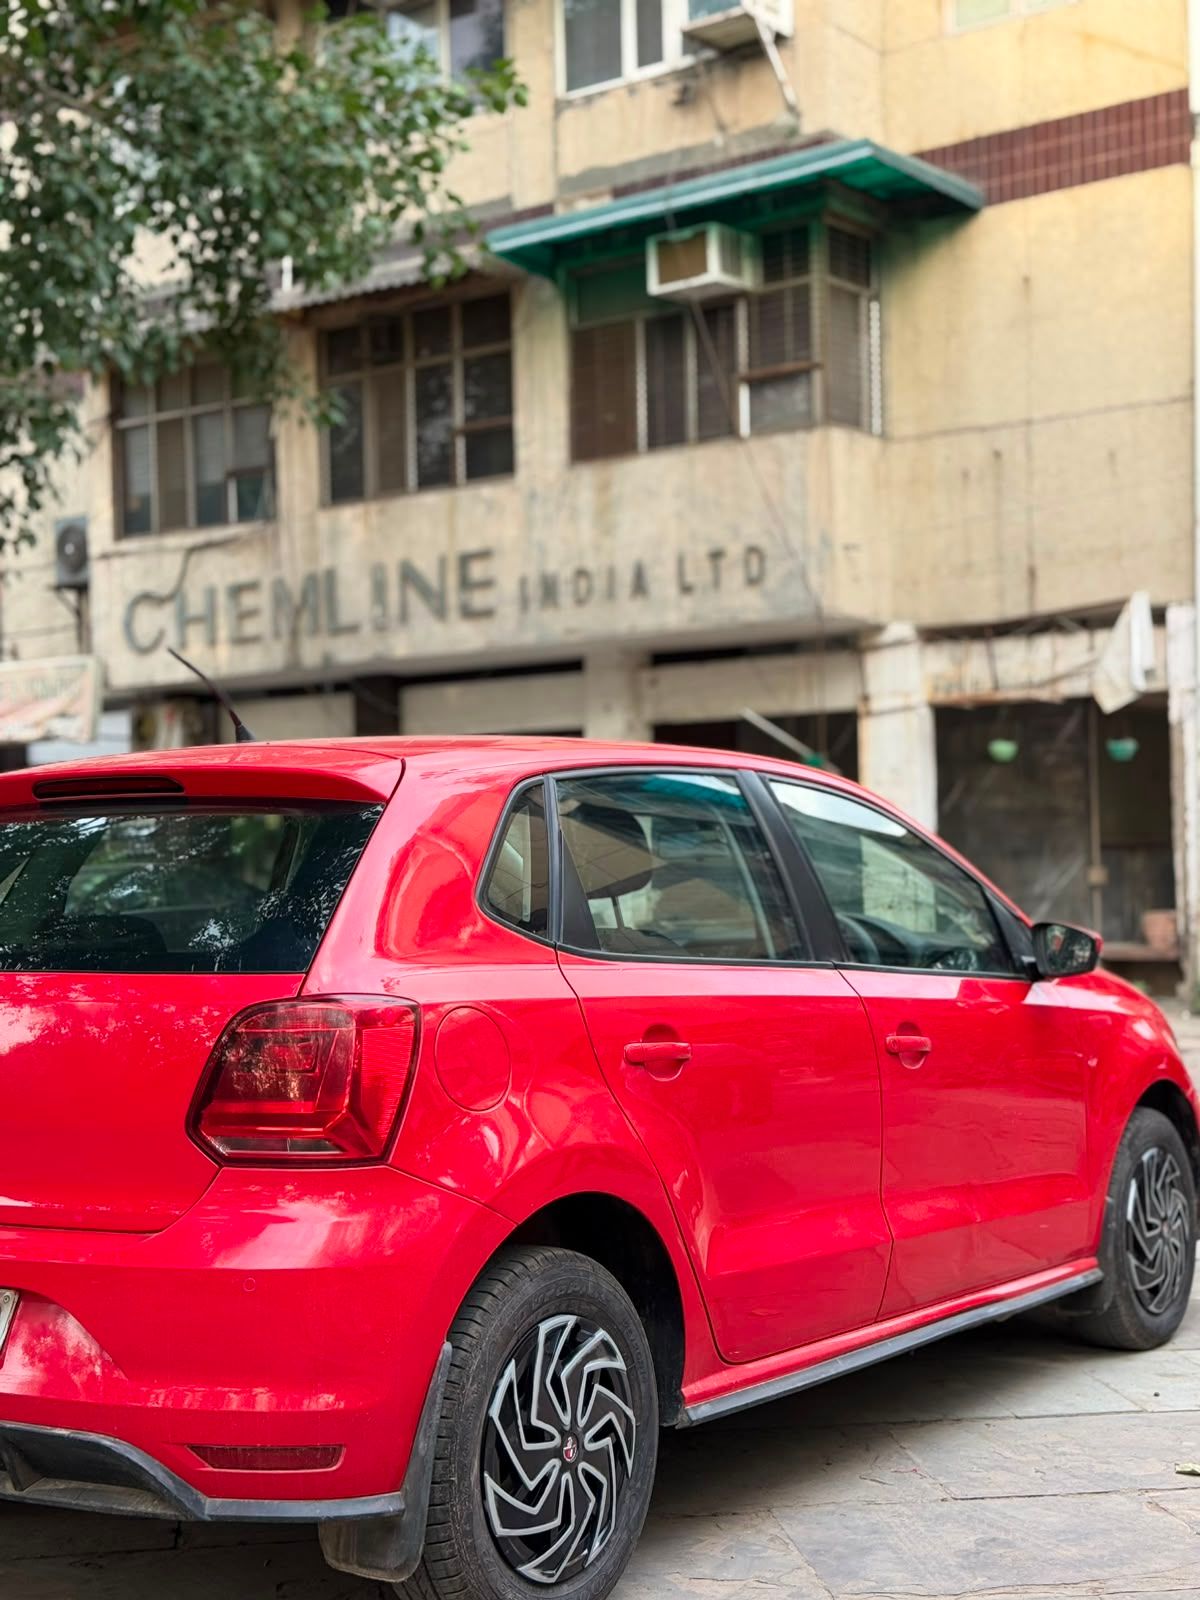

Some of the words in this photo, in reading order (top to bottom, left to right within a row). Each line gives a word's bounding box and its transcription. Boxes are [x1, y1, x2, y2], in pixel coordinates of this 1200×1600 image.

[123, 550, 496, 656] CHEMLINE
[519, 560, 650, 616] INDIA
[676, 546, 767, 597] LTD
